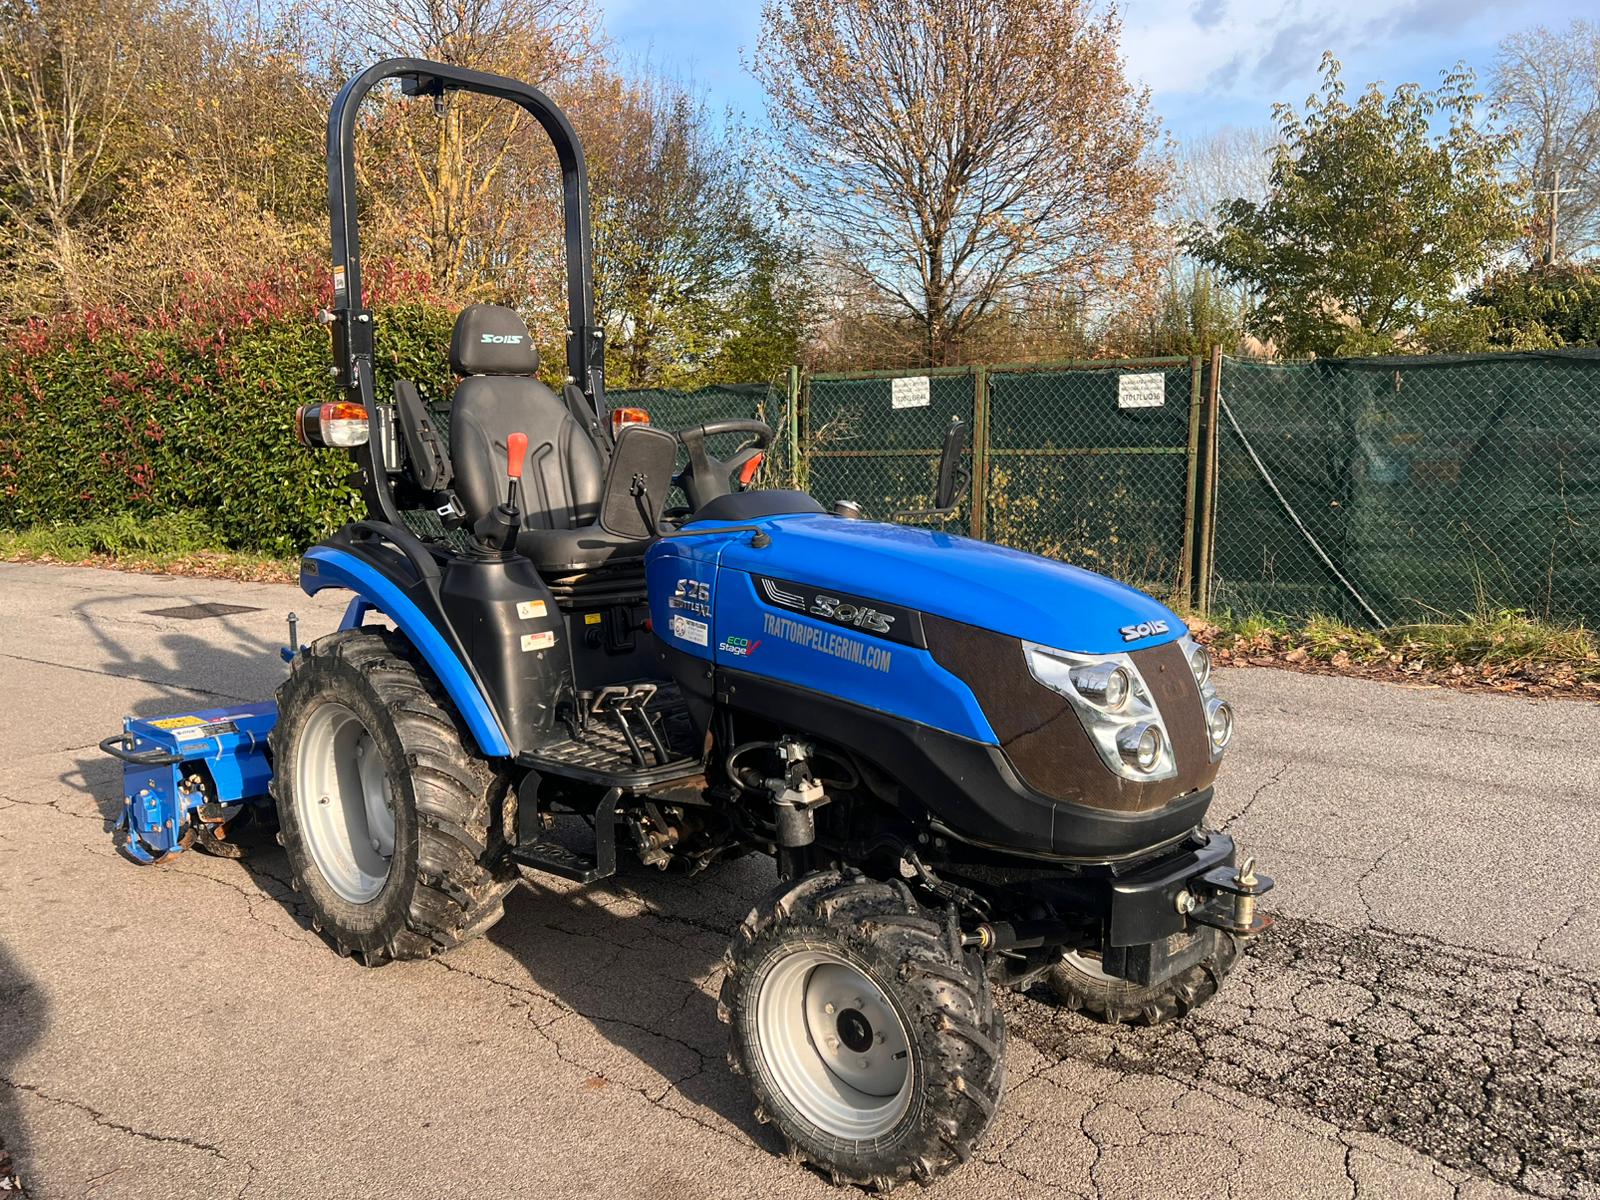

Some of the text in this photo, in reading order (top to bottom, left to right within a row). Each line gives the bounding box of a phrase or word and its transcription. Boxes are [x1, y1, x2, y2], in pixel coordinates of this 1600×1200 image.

[669, 597, 699, 612] UTTLE
[727, 636, 748, 647] ECO
[763, 612, 892, 674] TRATTORIPELLEGRINI.COM
